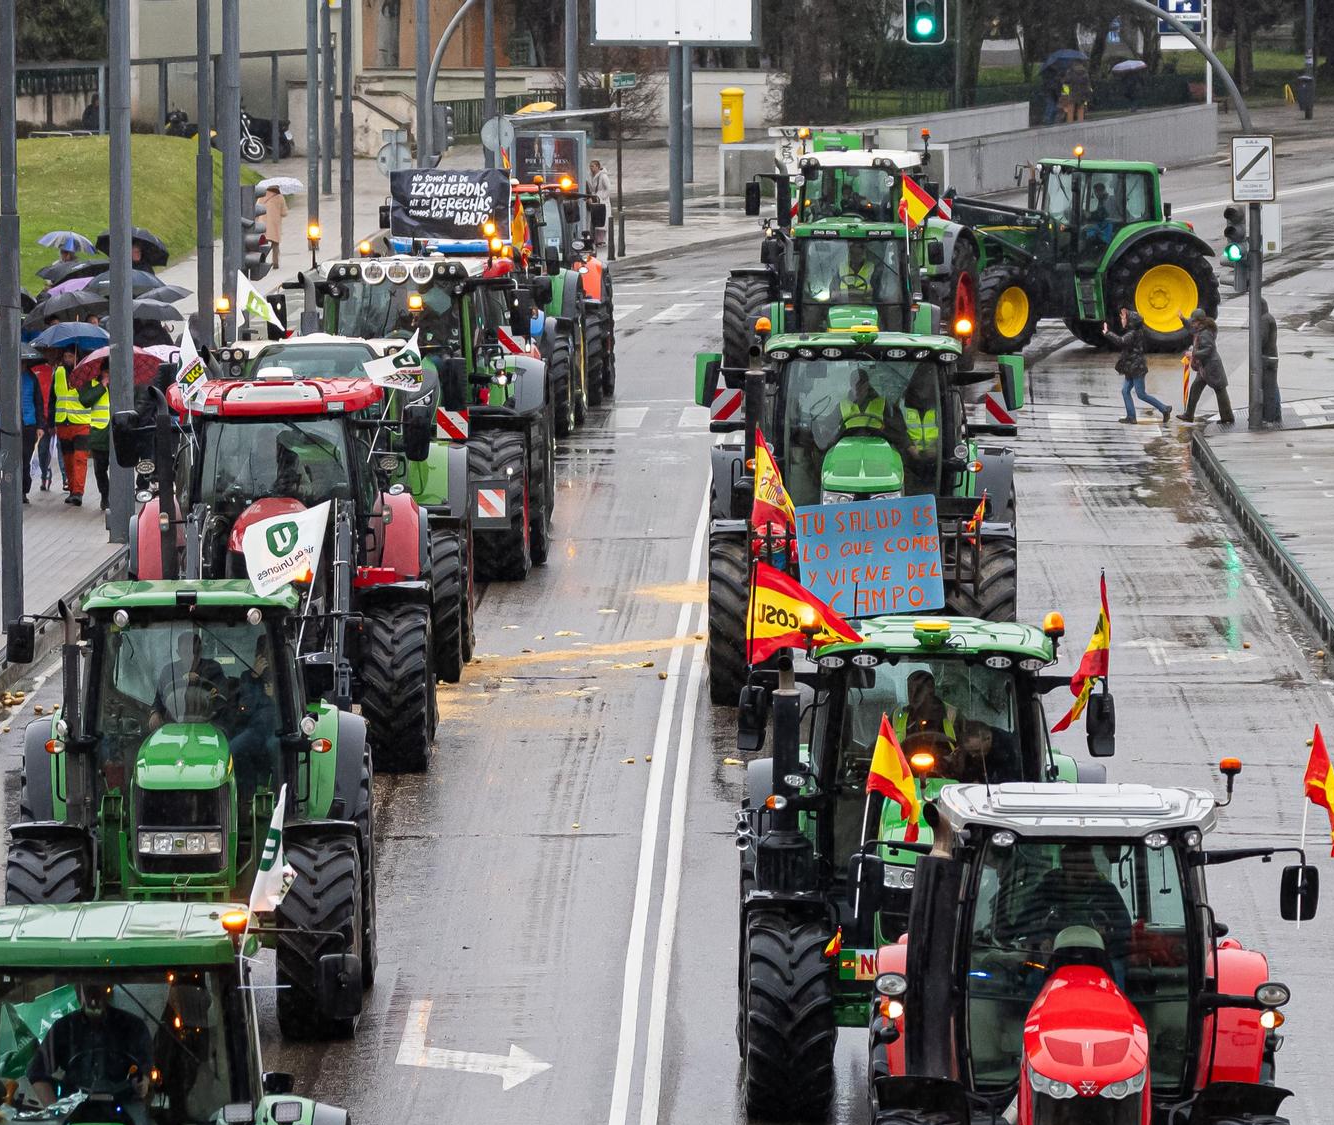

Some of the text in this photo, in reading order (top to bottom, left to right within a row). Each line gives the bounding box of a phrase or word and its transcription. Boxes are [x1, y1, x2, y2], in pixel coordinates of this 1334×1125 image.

[412, 174, 469, 183] NO SOMOS NI DE
[410, 182, 489, 197] IZQUIERDAS
[409, 199, 418, 207] NI
[408, 209, 430, 218] SOMOS
[432, 209, 444, 218] LOS
[445, 209, 455, 218] DE
[796, 505, 935, 536] TU SALUD ES
[803, 535, 939, 562] LO QUE COMES
[906, 561, 942, 581] DEL
